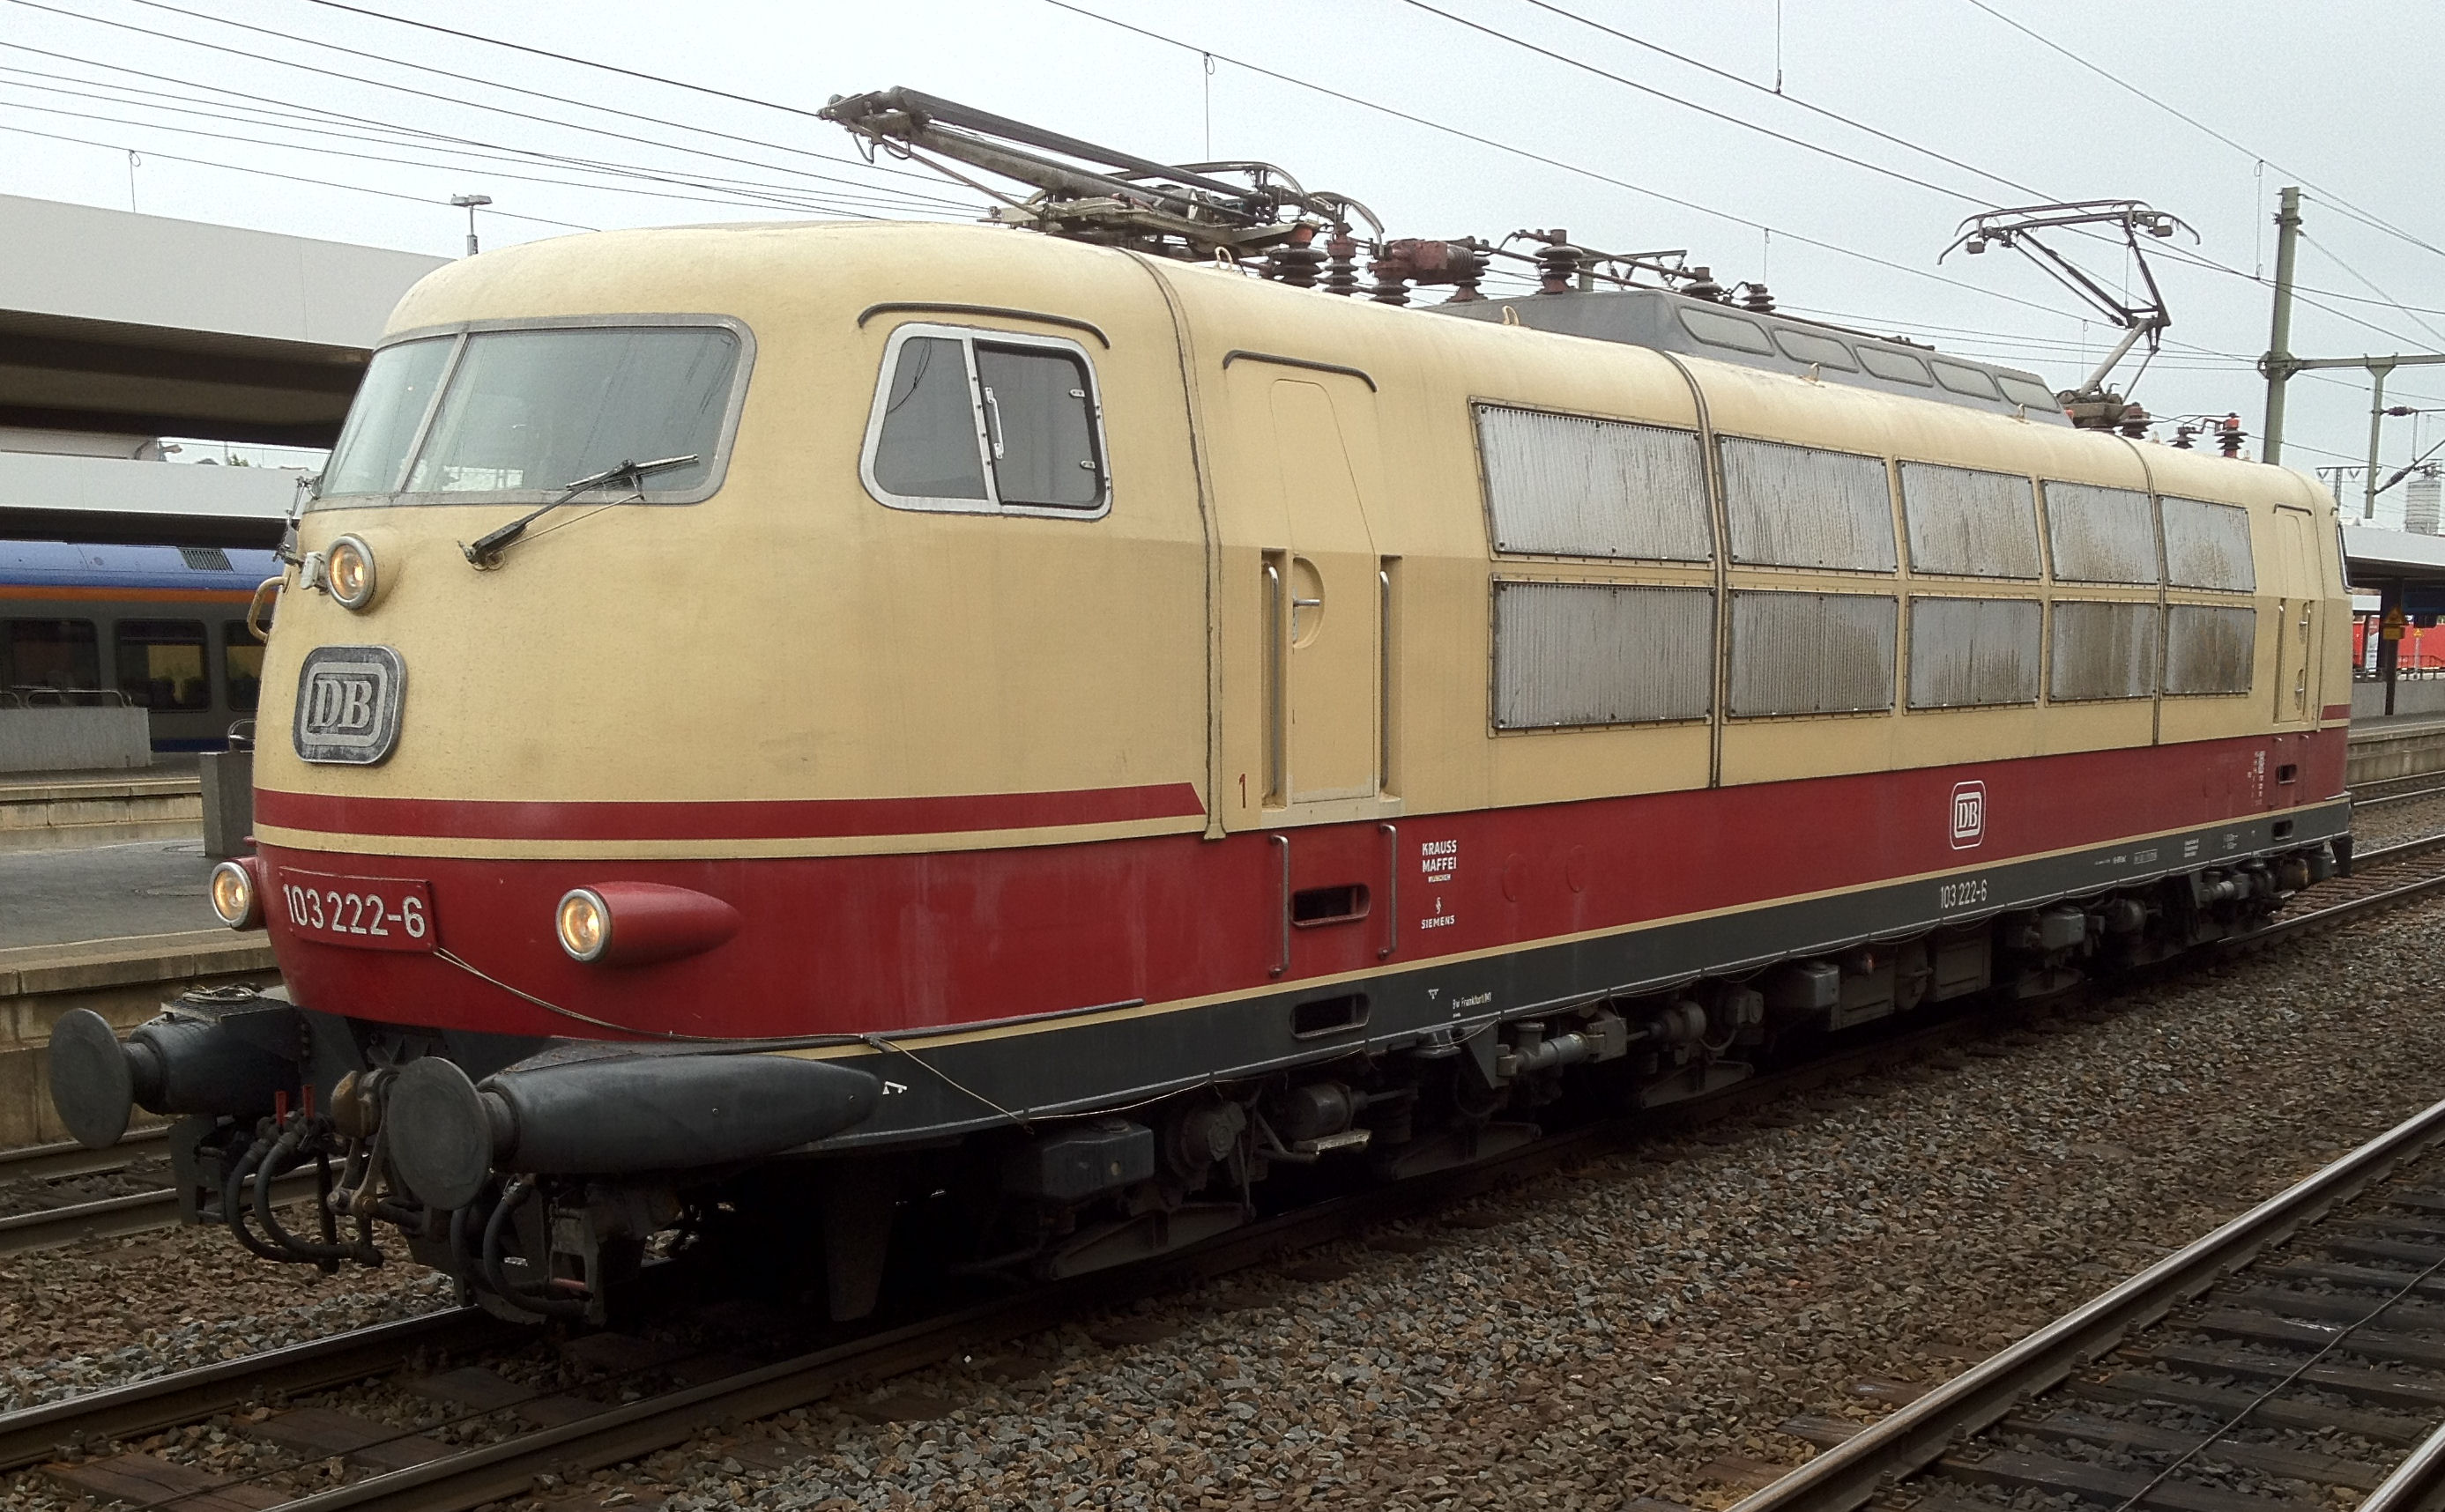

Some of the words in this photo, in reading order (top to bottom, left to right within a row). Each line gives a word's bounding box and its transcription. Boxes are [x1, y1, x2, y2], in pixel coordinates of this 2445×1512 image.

[311, 678, 373, 729] DB
[1238, 773, 1246, 809] 1
[1957, 801, 1978, 828] DB
[1422, 840, 1457, 856] KRAUSS
[1422, 856, 1457, 872] MAFFEI
[1940, 884, 1957, 909] 103
[1958, 878, 1988, 906] 222-6
[283, 883, 324, 930] 103
[326, 890, 426, 938] 222-6
[1421, 915, 1455, 930] SIEMENS
